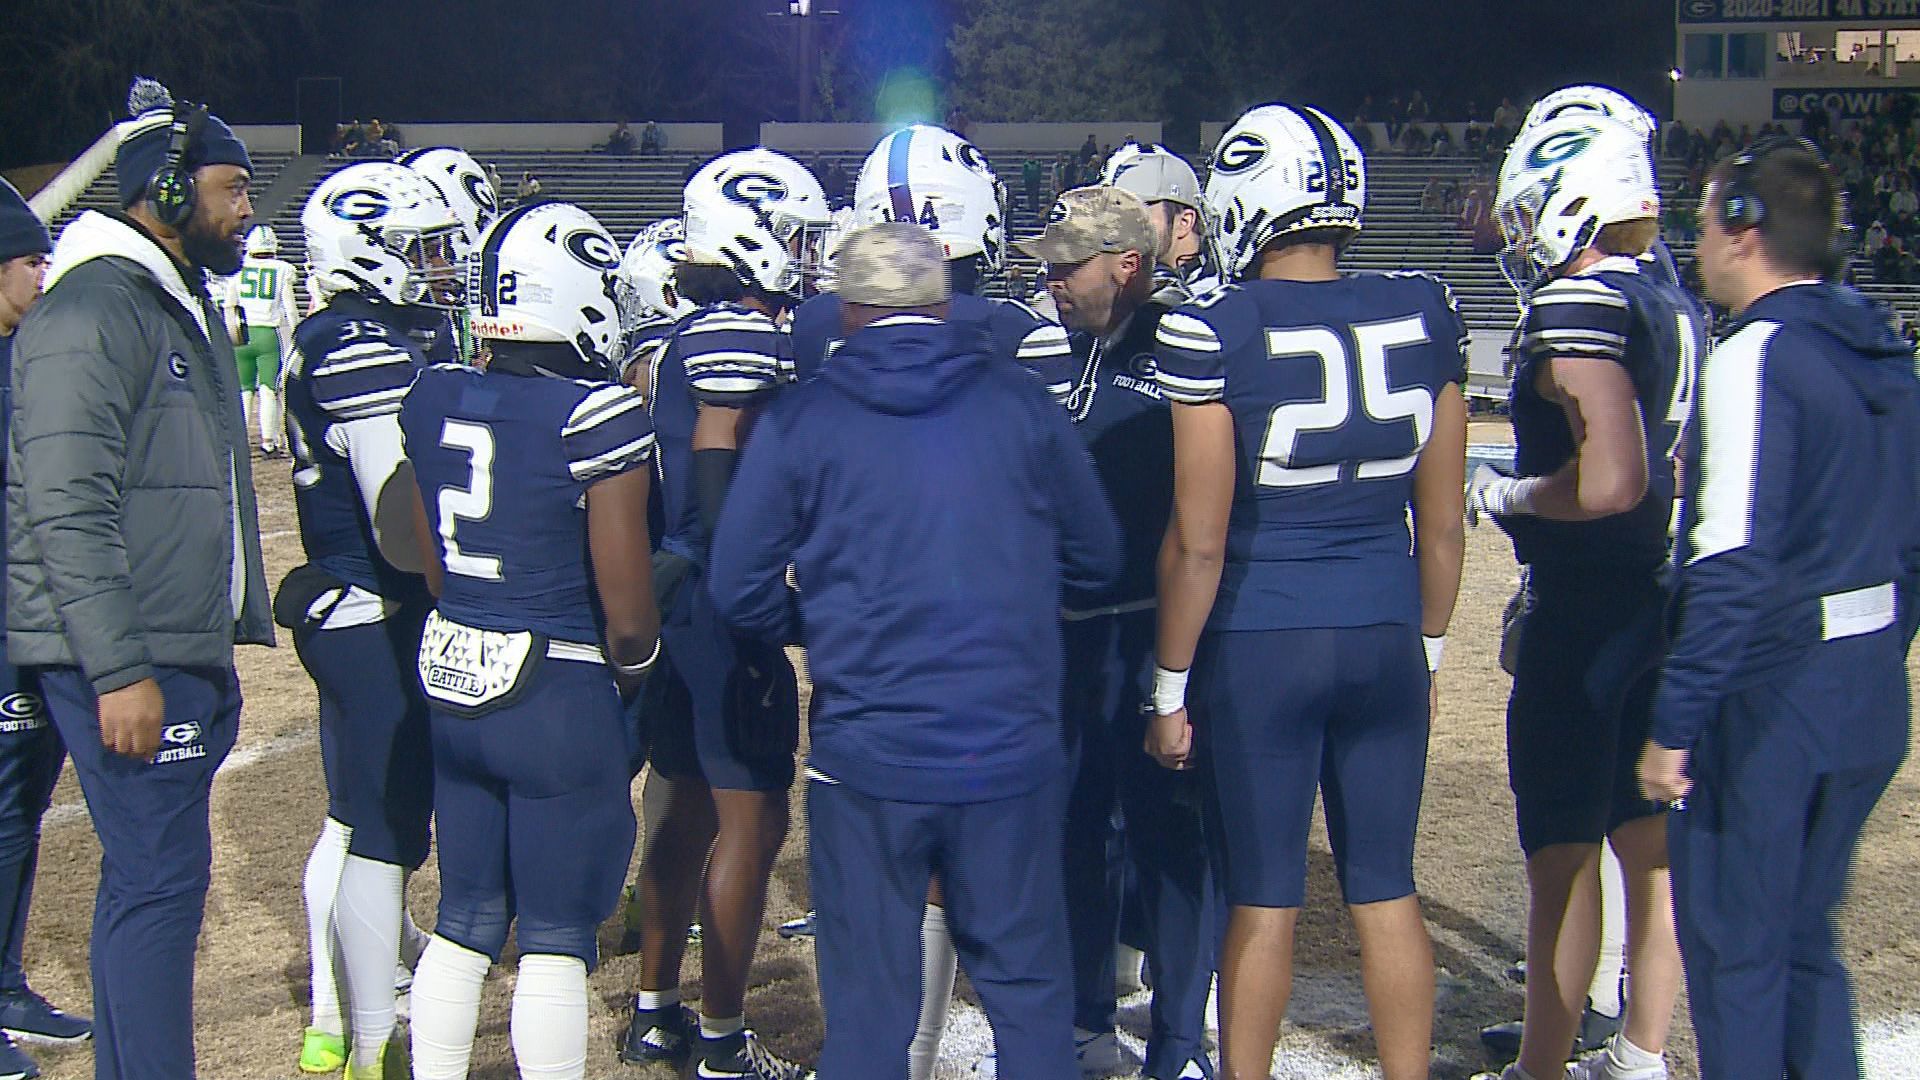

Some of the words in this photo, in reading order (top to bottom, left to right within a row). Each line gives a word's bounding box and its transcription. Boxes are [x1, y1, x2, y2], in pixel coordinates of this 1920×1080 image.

[240, 266, 277, 299] 50
[499, 273, 517, 305] 2
[1112, 374, 1162, 401] FOOTBALL
[1254, 312, 1435, 489] 25
[438, 417, 506, 582] 2
[431, 669, 479, 693] BATTLE
[151, 744, 206, 764] OOTBALL
